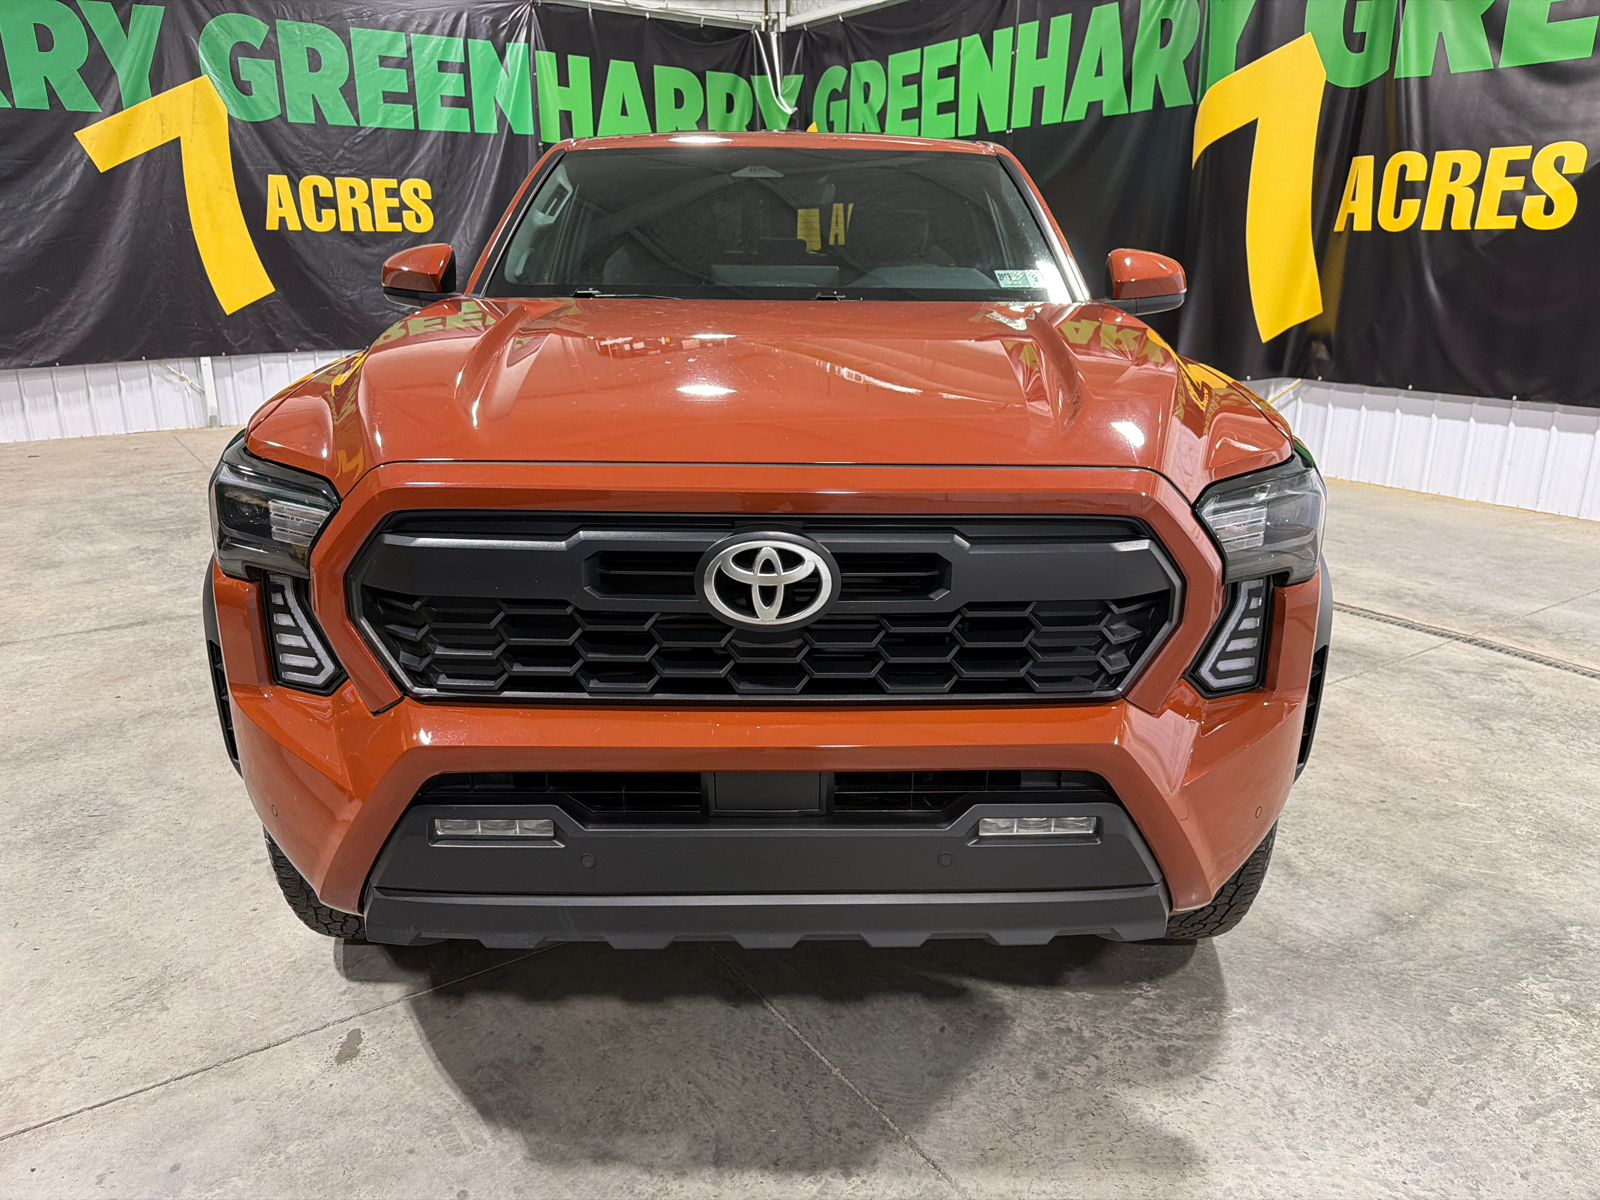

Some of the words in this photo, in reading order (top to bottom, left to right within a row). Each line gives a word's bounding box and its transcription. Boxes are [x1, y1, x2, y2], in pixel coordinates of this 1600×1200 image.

[0, 0, 165, 112] RY
[200, 13, 534, 134] GREEN
[535, 50, 805, 143] HARRY
[812, 37, 1014, 138] GREEN
[75, 74, 276, 315] 7
[265, 174, 435, 233] ACRES
[1193, 31, 1326, 343] 7
[1333, 141, 1588, 232] ACRES
